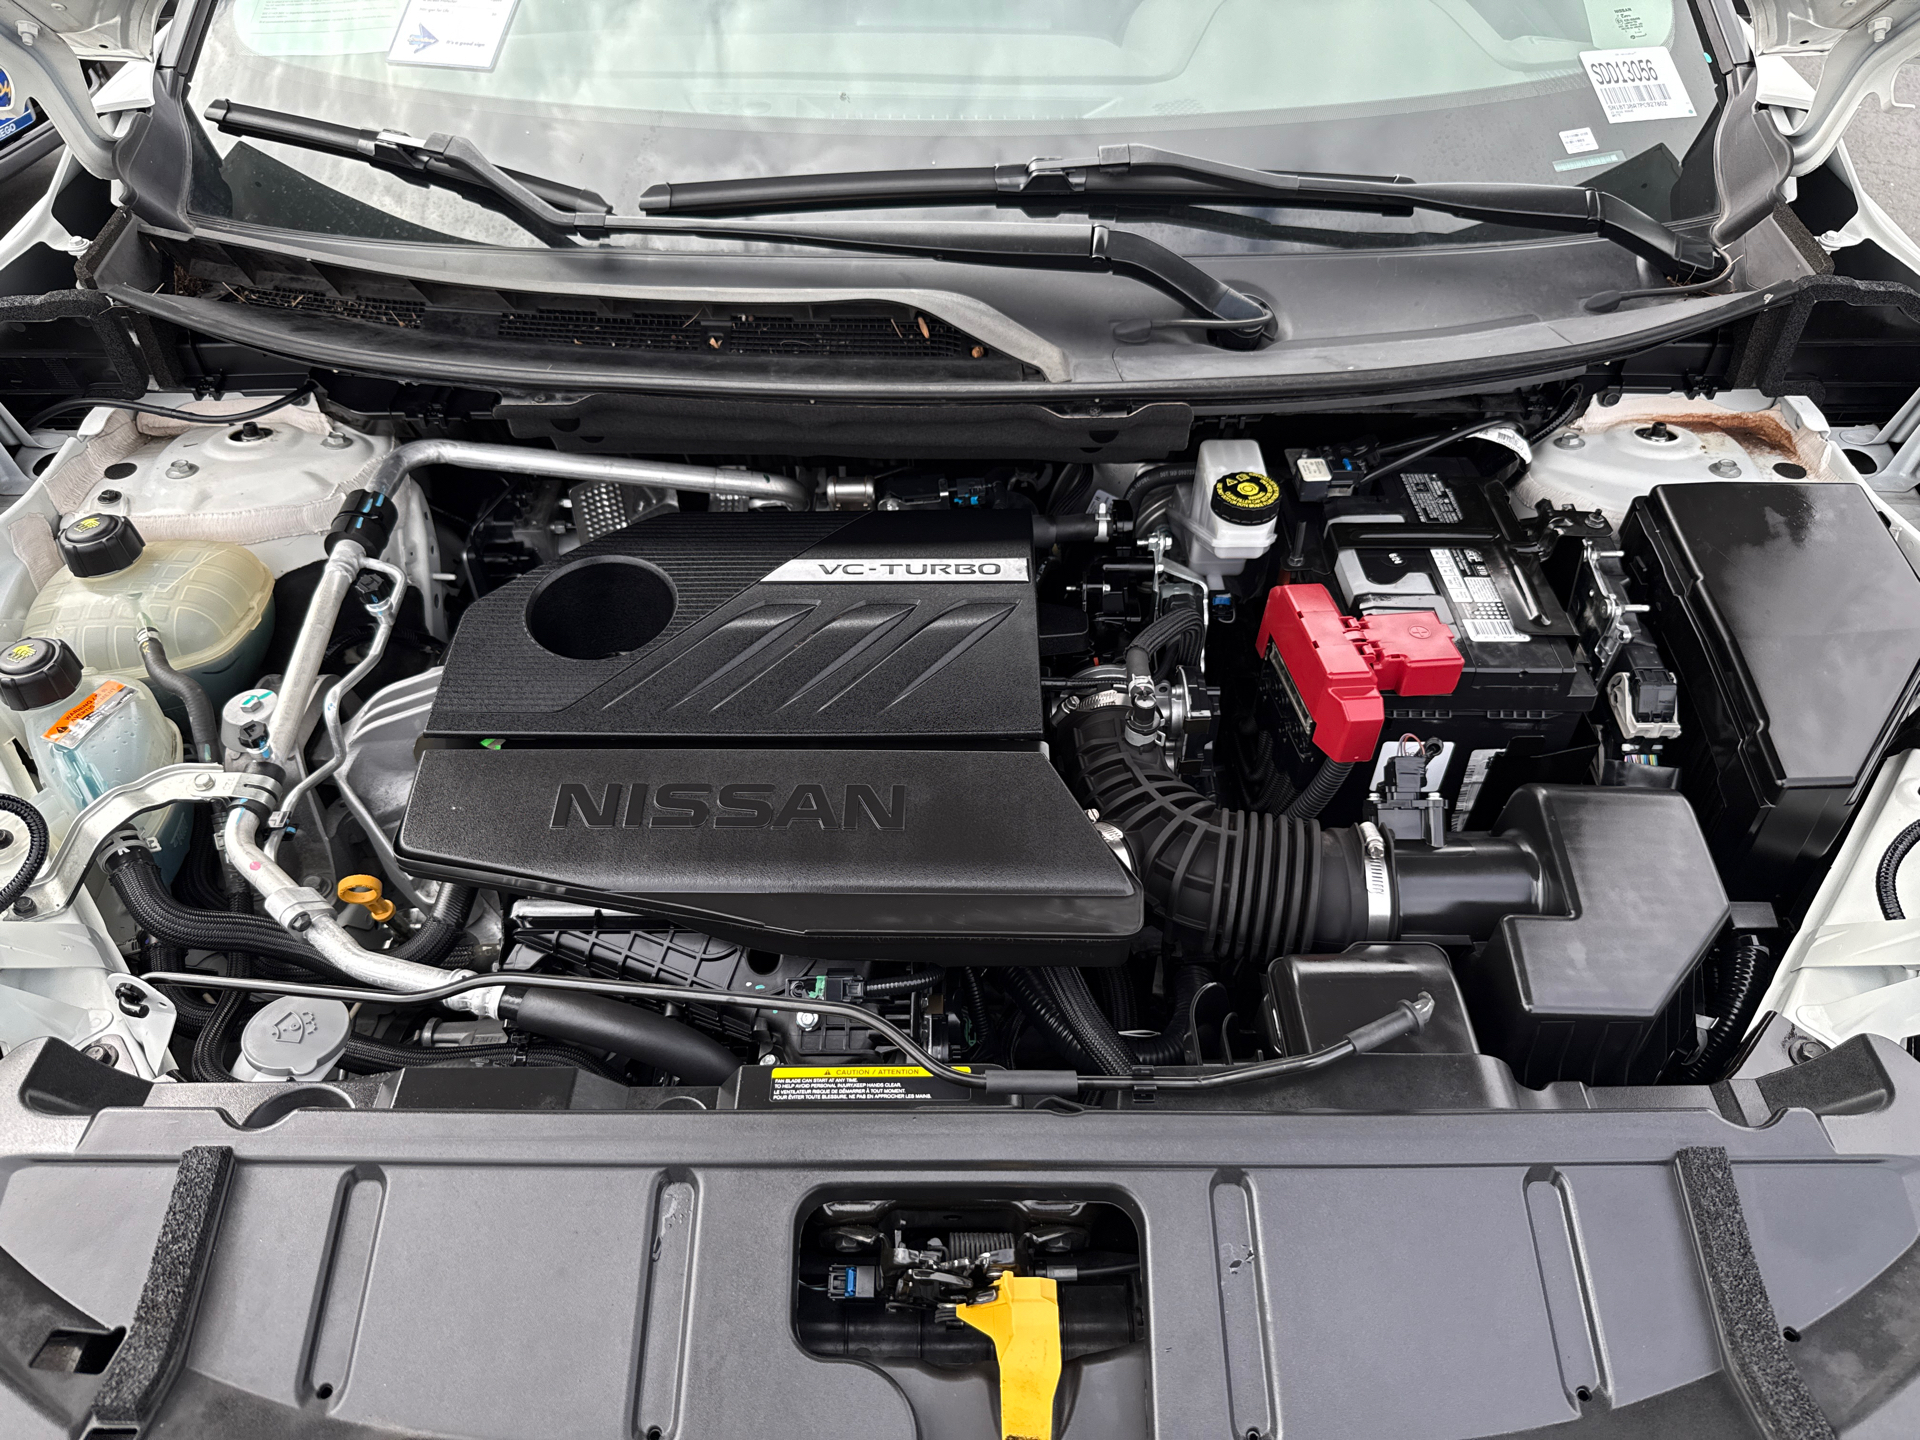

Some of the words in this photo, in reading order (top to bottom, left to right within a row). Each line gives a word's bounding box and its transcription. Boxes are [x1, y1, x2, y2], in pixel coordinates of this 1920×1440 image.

[817, 563, 1001, 576] VC-TURBO
[65, 699, 93, 721] WARNING
[549, 783, 907, 831] NISSAN
